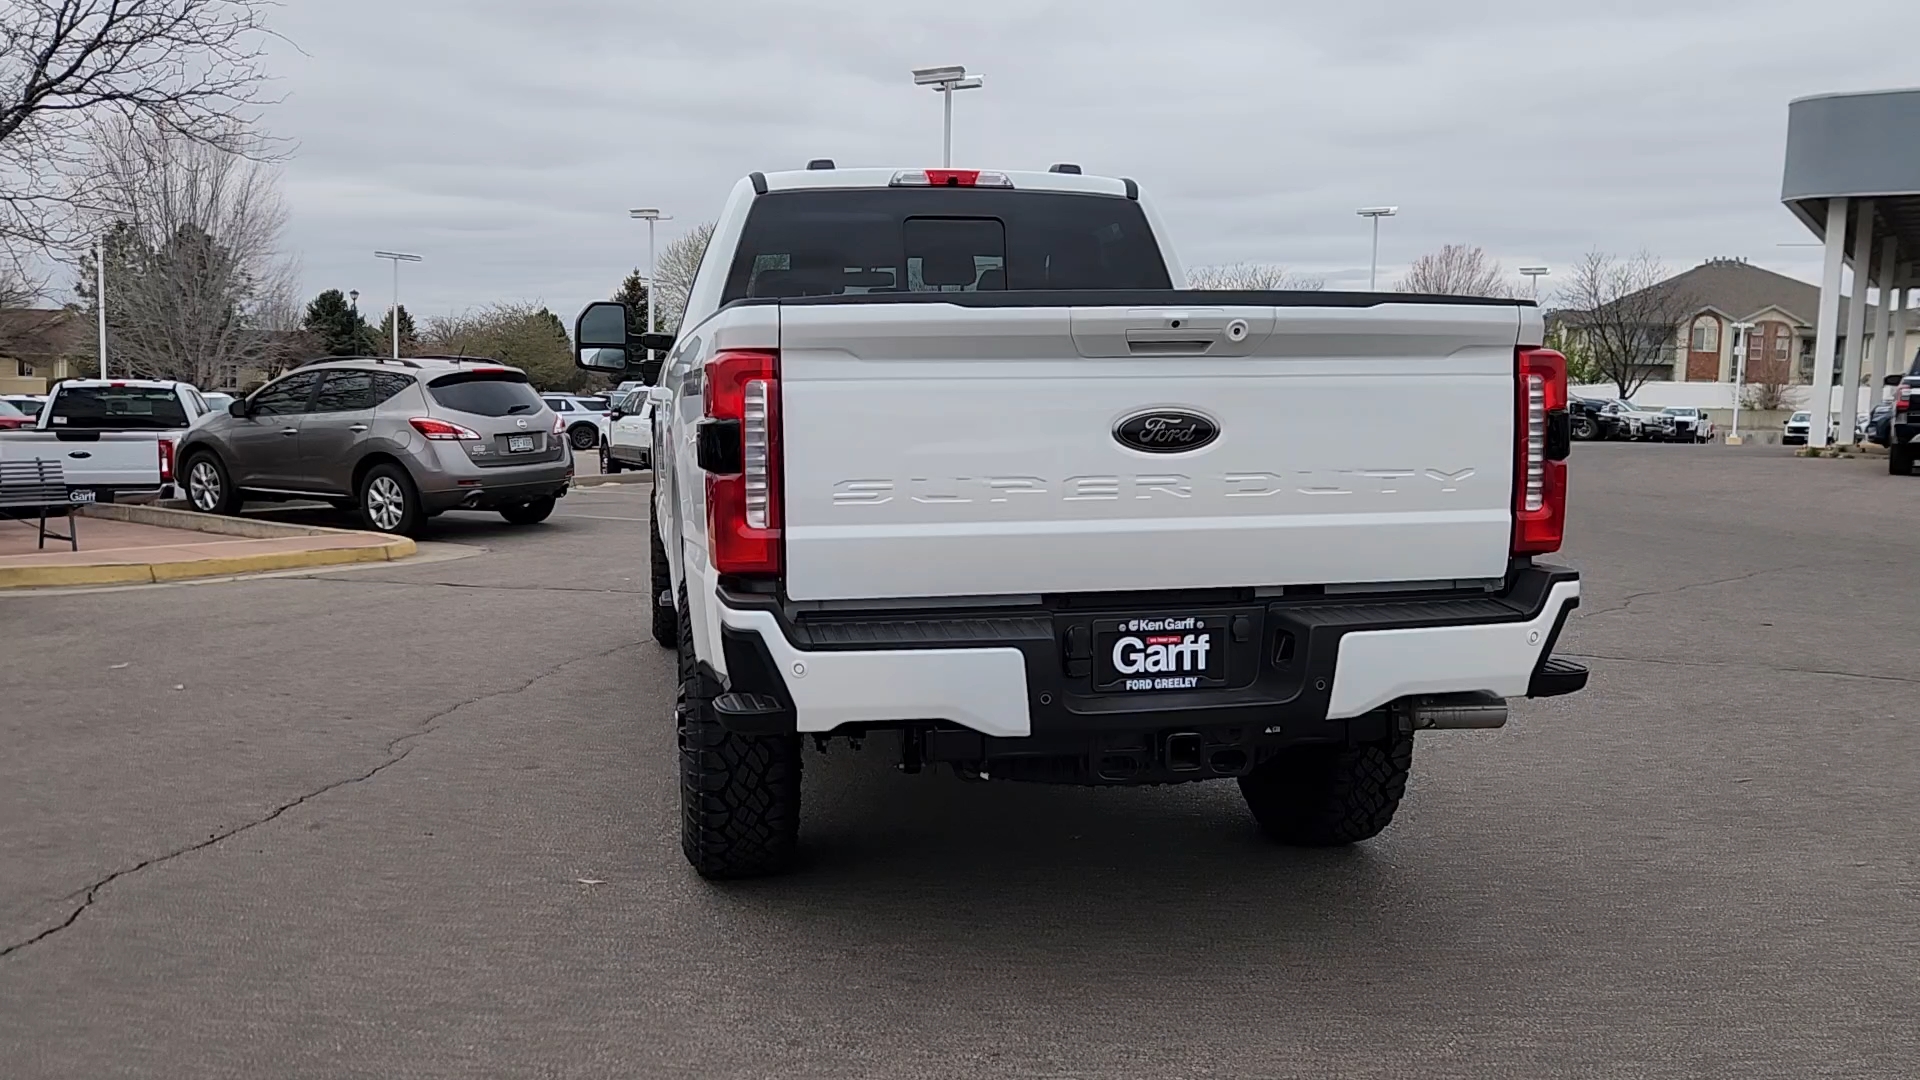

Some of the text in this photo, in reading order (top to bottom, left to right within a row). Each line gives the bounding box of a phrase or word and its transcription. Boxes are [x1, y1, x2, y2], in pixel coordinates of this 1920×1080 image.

[1139, 417, 1197, 442] Ford
[833, 467, 1475, 505] SUPER DUTY
[1140, 617, 1196, 631] Ken Garff
[1112, 633, 1210, 674] Garff
[1126, 677, 1198, 690] FORD GREELEY
